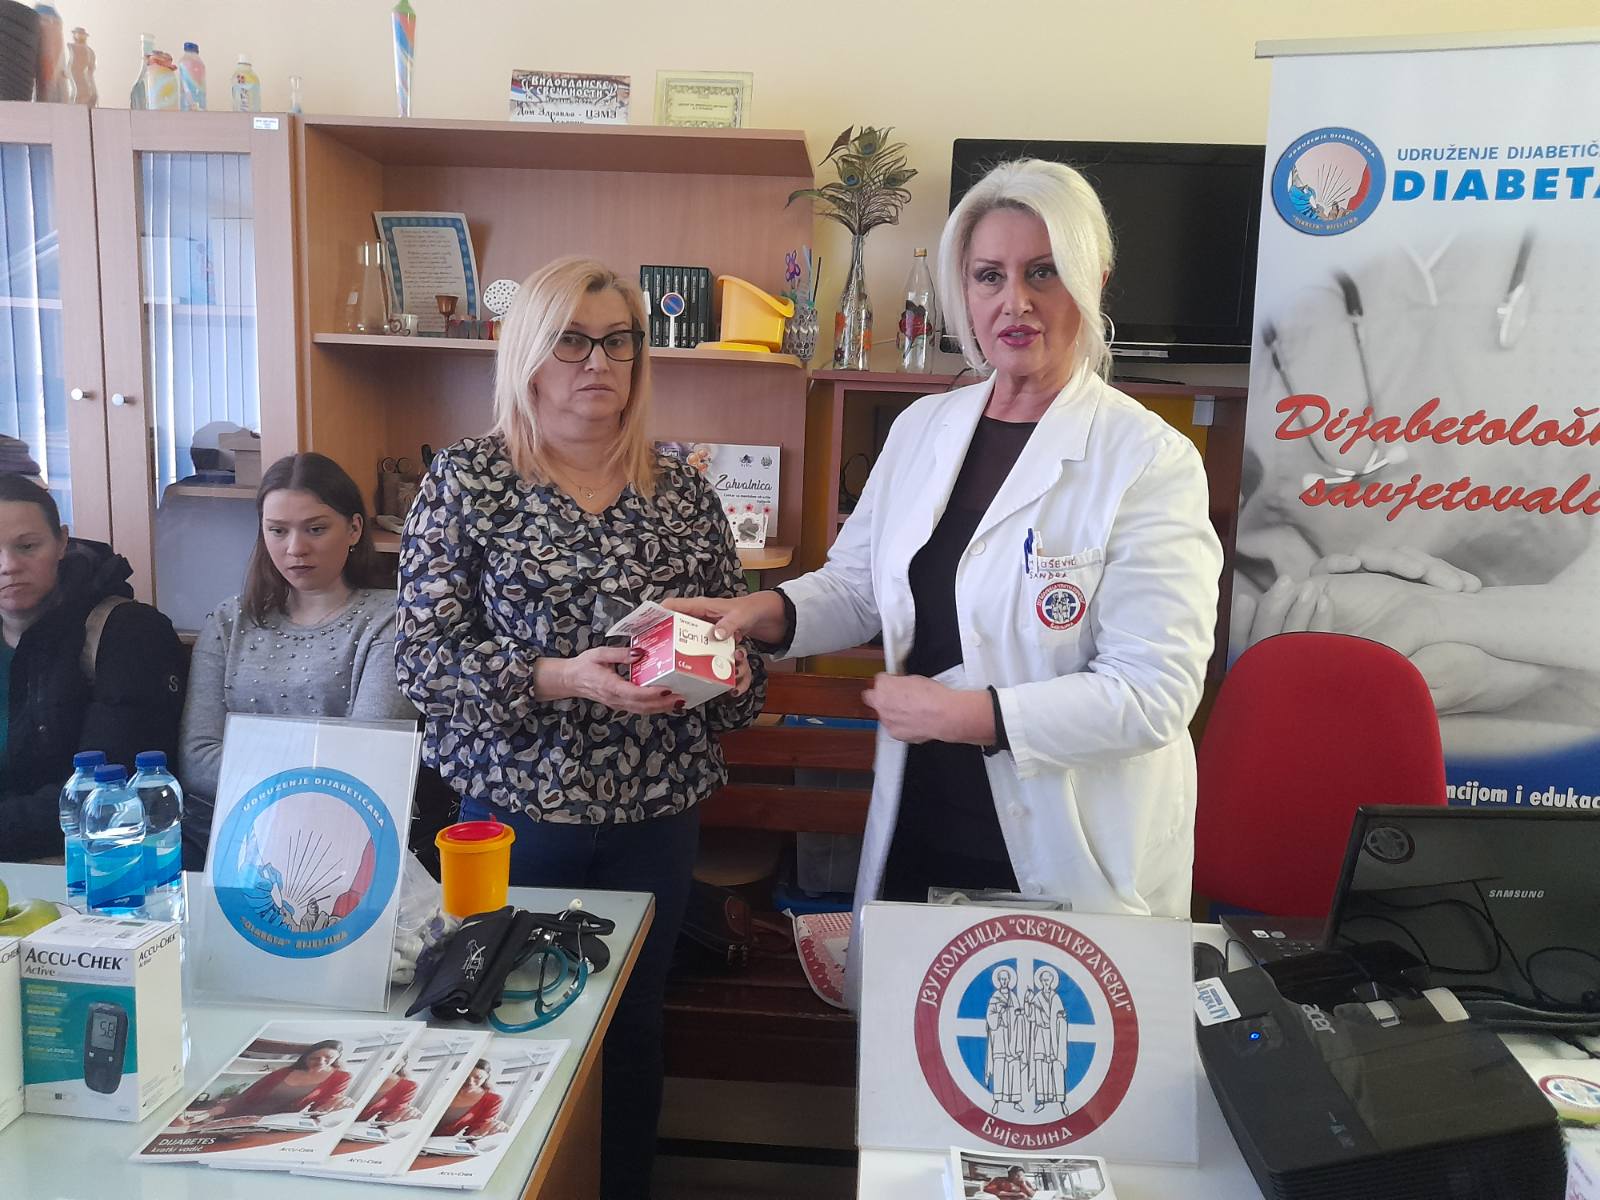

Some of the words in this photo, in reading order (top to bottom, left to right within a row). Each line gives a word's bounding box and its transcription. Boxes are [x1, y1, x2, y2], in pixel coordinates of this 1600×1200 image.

[1397, 144, 1499, 161] UDRUŽENJE
[1507, 140, 1600, 160] DIJABETIČ
[1392, 166, 1600, 201] DIABET
[715, 474, 772, 491] Zahvalnica
[1516, 785, 1523, 804] i
[1489, 889, 1545, 898] SAMSUNG
[25, 947, 122, 970] ACCU-CHEK
[933, 921, 1007, 980] БОЛНИЦА
[25, 965, 56, 976] Active
[1301, 1004, 1336, 1034] acer
[981, 1116, 1073, 1147] Бијељина
